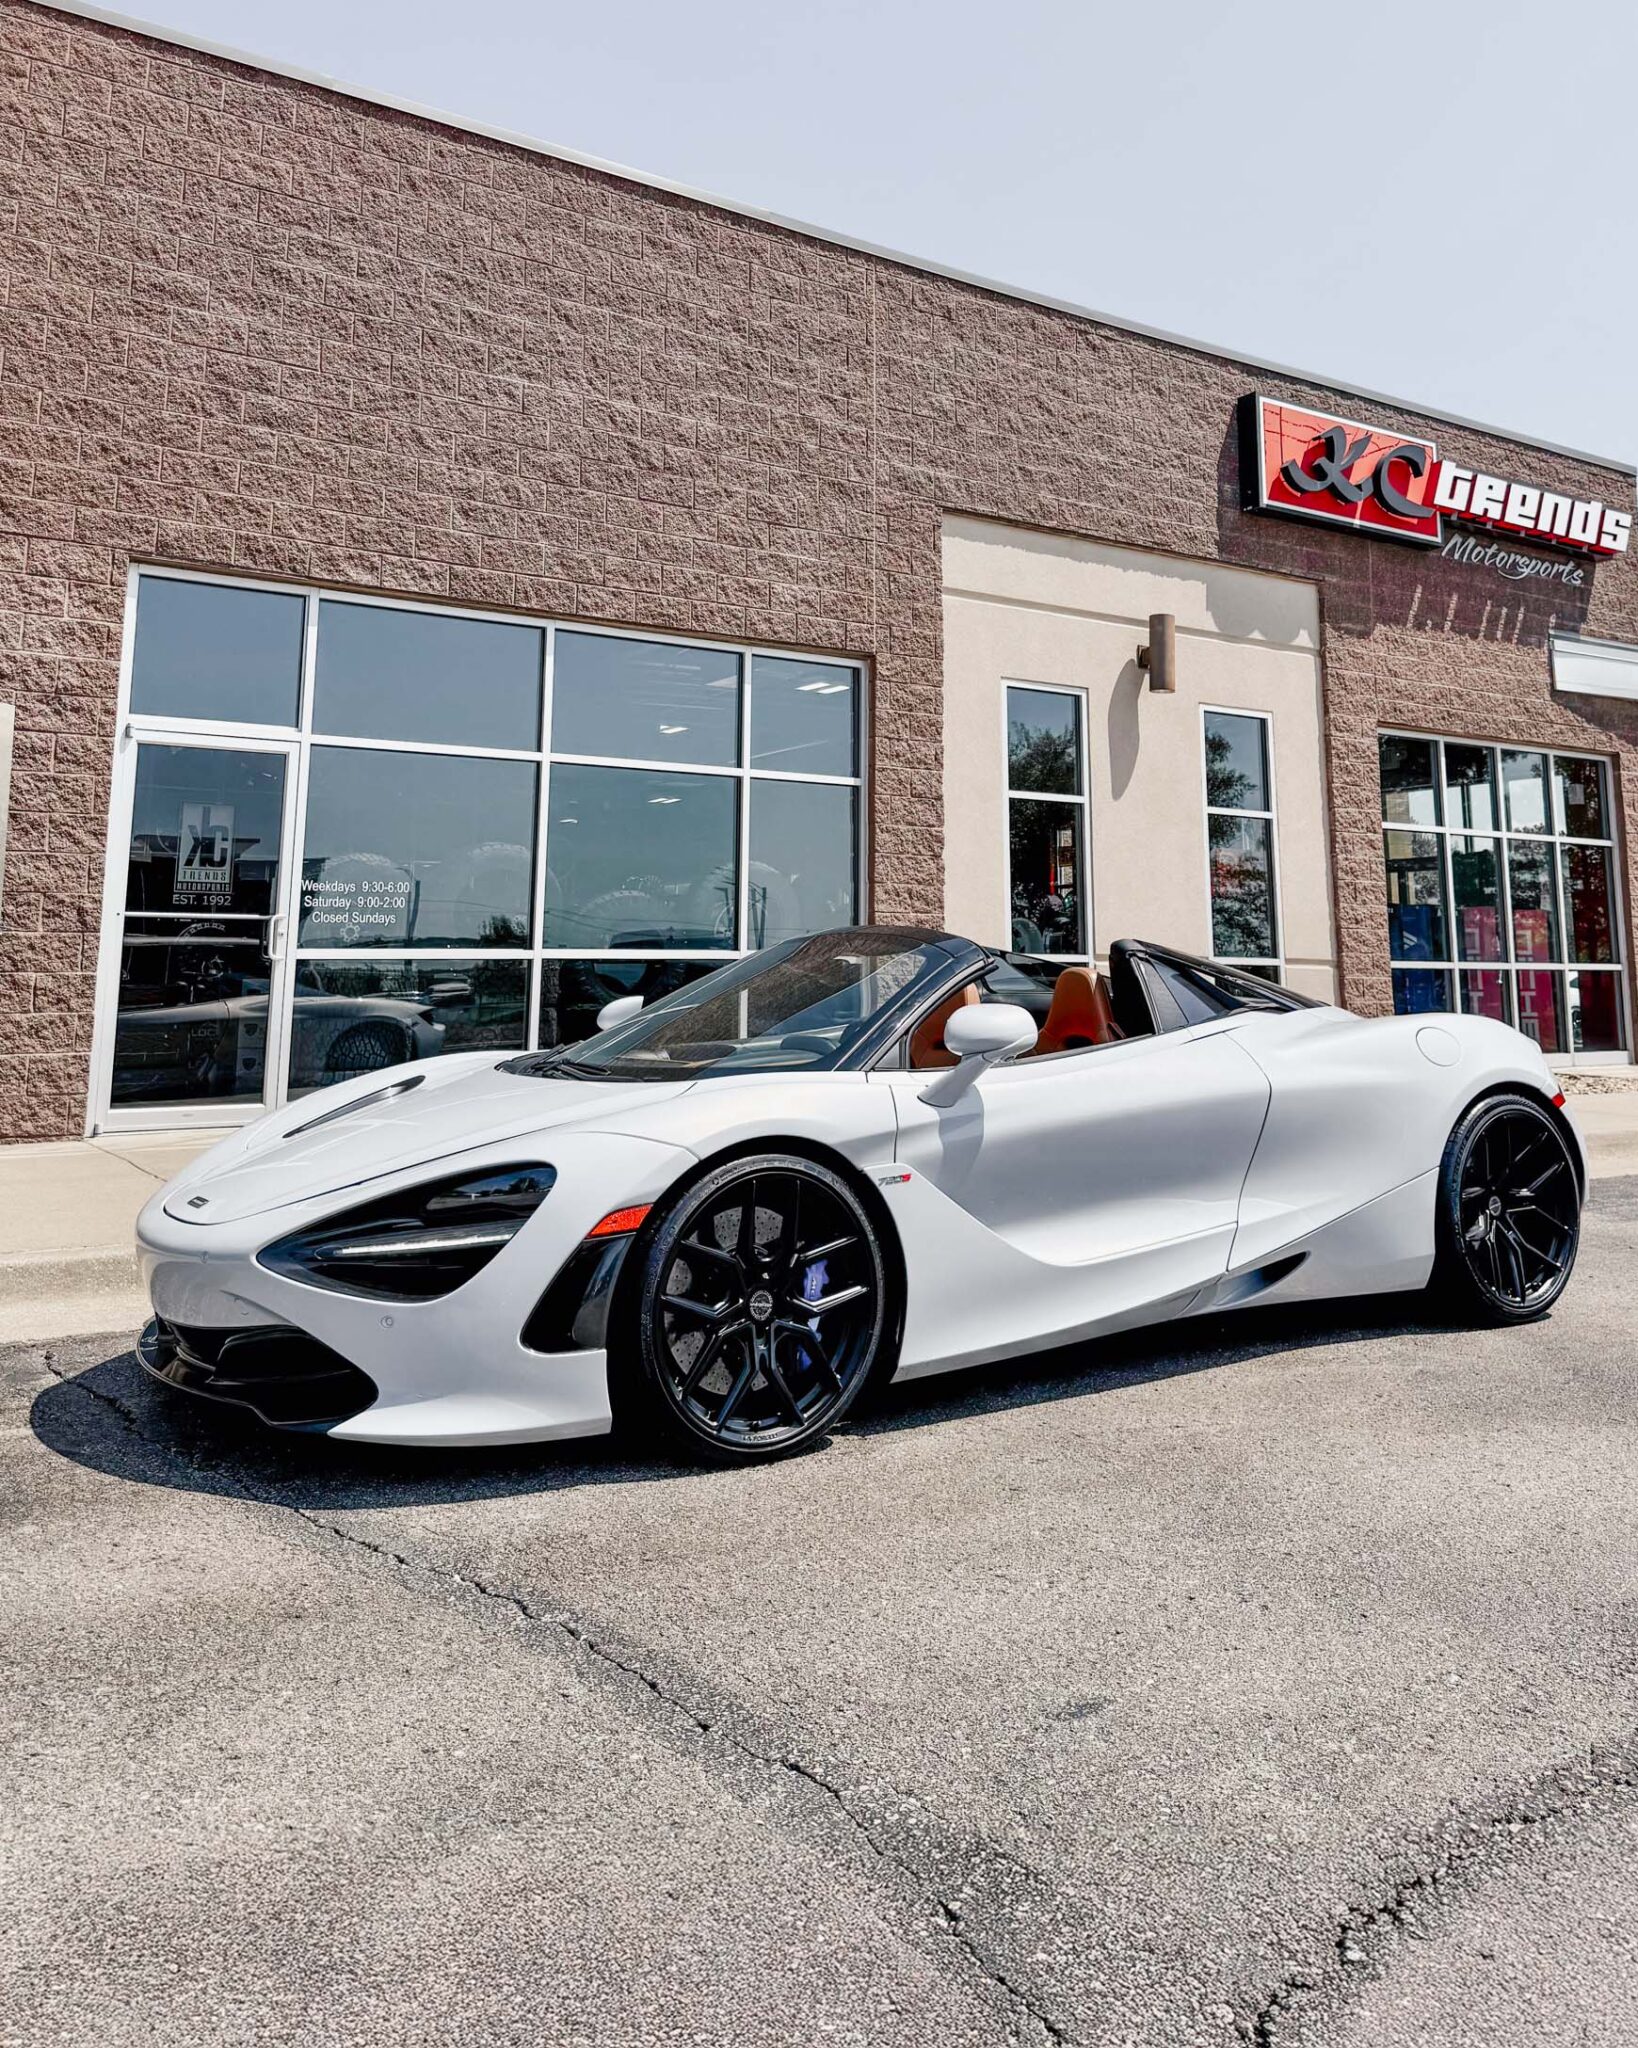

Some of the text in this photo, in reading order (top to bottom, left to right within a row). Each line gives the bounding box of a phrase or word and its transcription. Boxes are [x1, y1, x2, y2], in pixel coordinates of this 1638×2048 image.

[1280, 425, 1436, 519] KC
[1440, 533, 1585, 586] Motorsports
[182, 870, 227, 881] TRENDS
[300, 879, 410, 894] Weekdays 9:30-6:00
[172, 894, 232, 906] EST. 1992
[303, 895, 406, 910] Saturday 9:00-2:00
[312, 911, 396, 926] Closed Sundays
